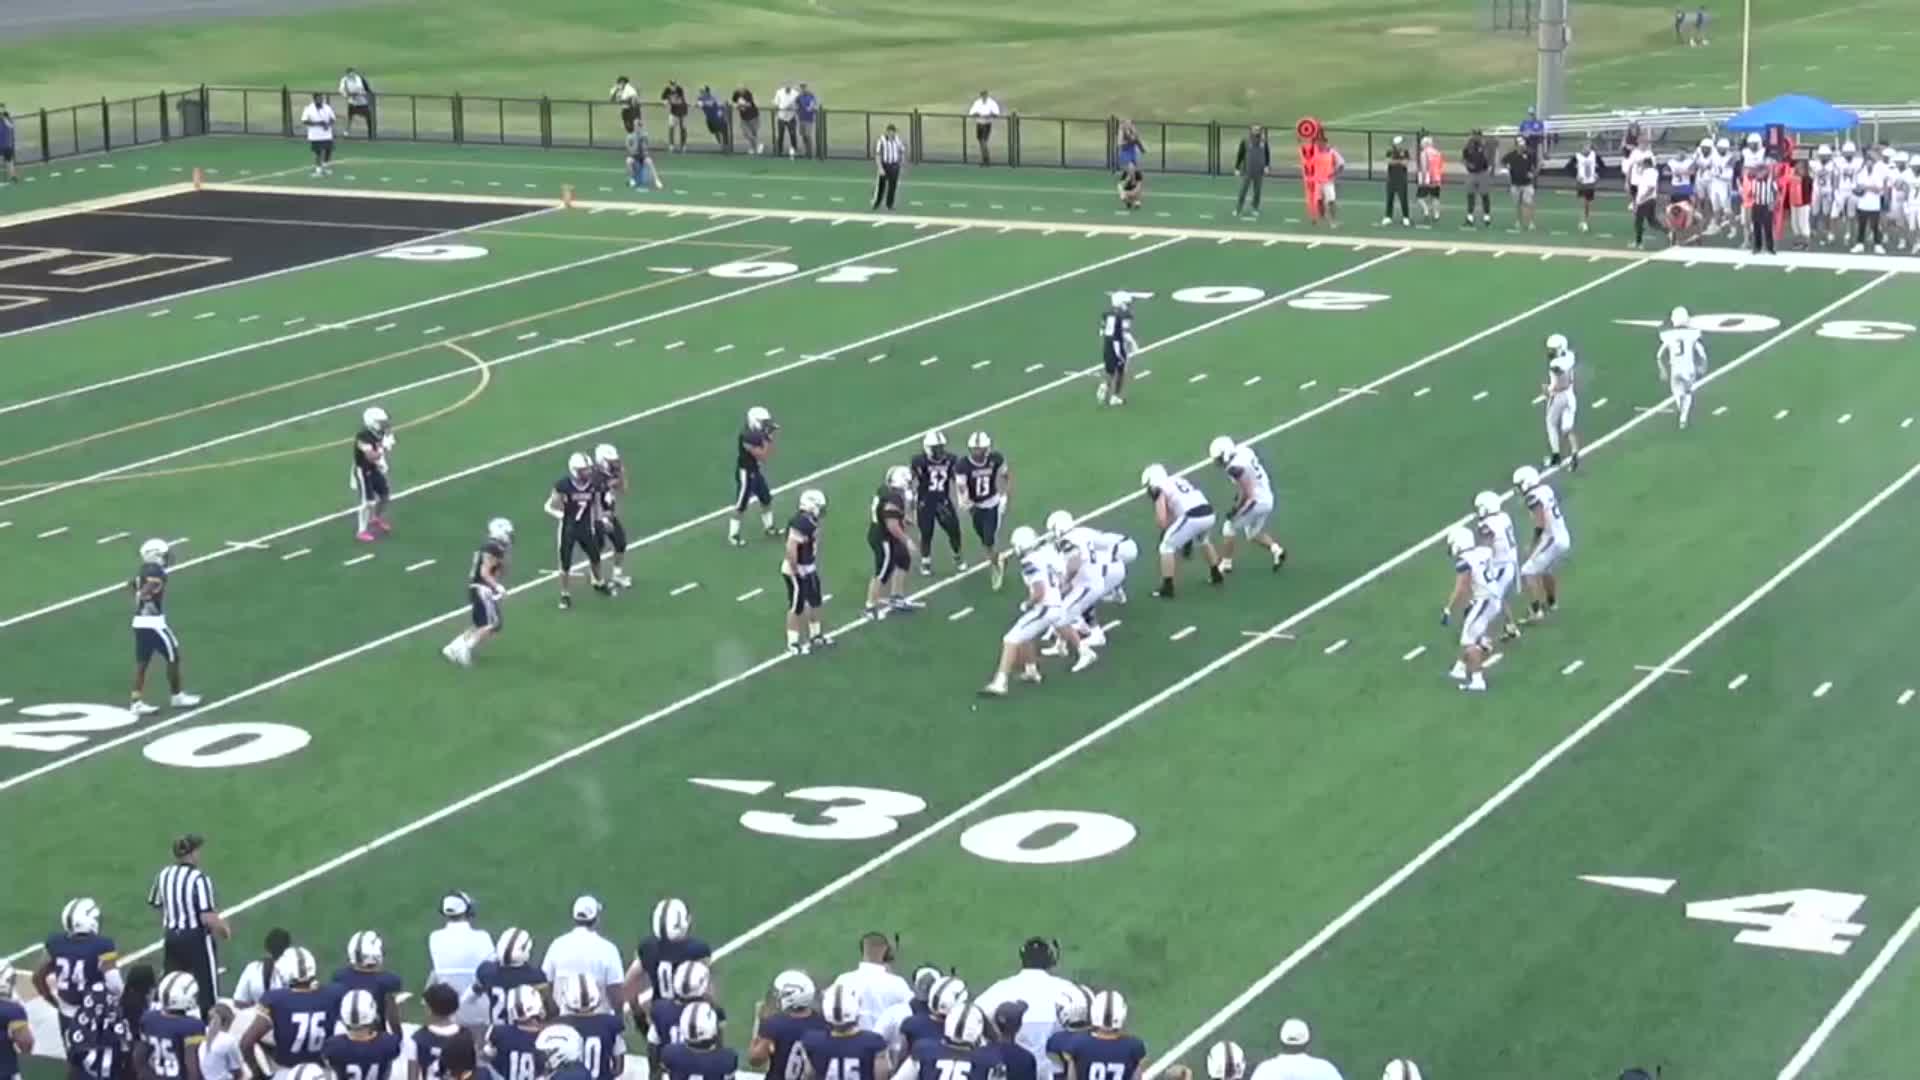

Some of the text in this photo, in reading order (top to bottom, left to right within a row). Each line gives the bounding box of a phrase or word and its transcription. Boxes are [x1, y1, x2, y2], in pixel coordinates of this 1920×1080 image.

[576, 501, 587, 521] 7
[1685, 888, 1868, 955] 4
[56, 957, 87, 991] 24
[290, 1010, 327, 1054] 76
